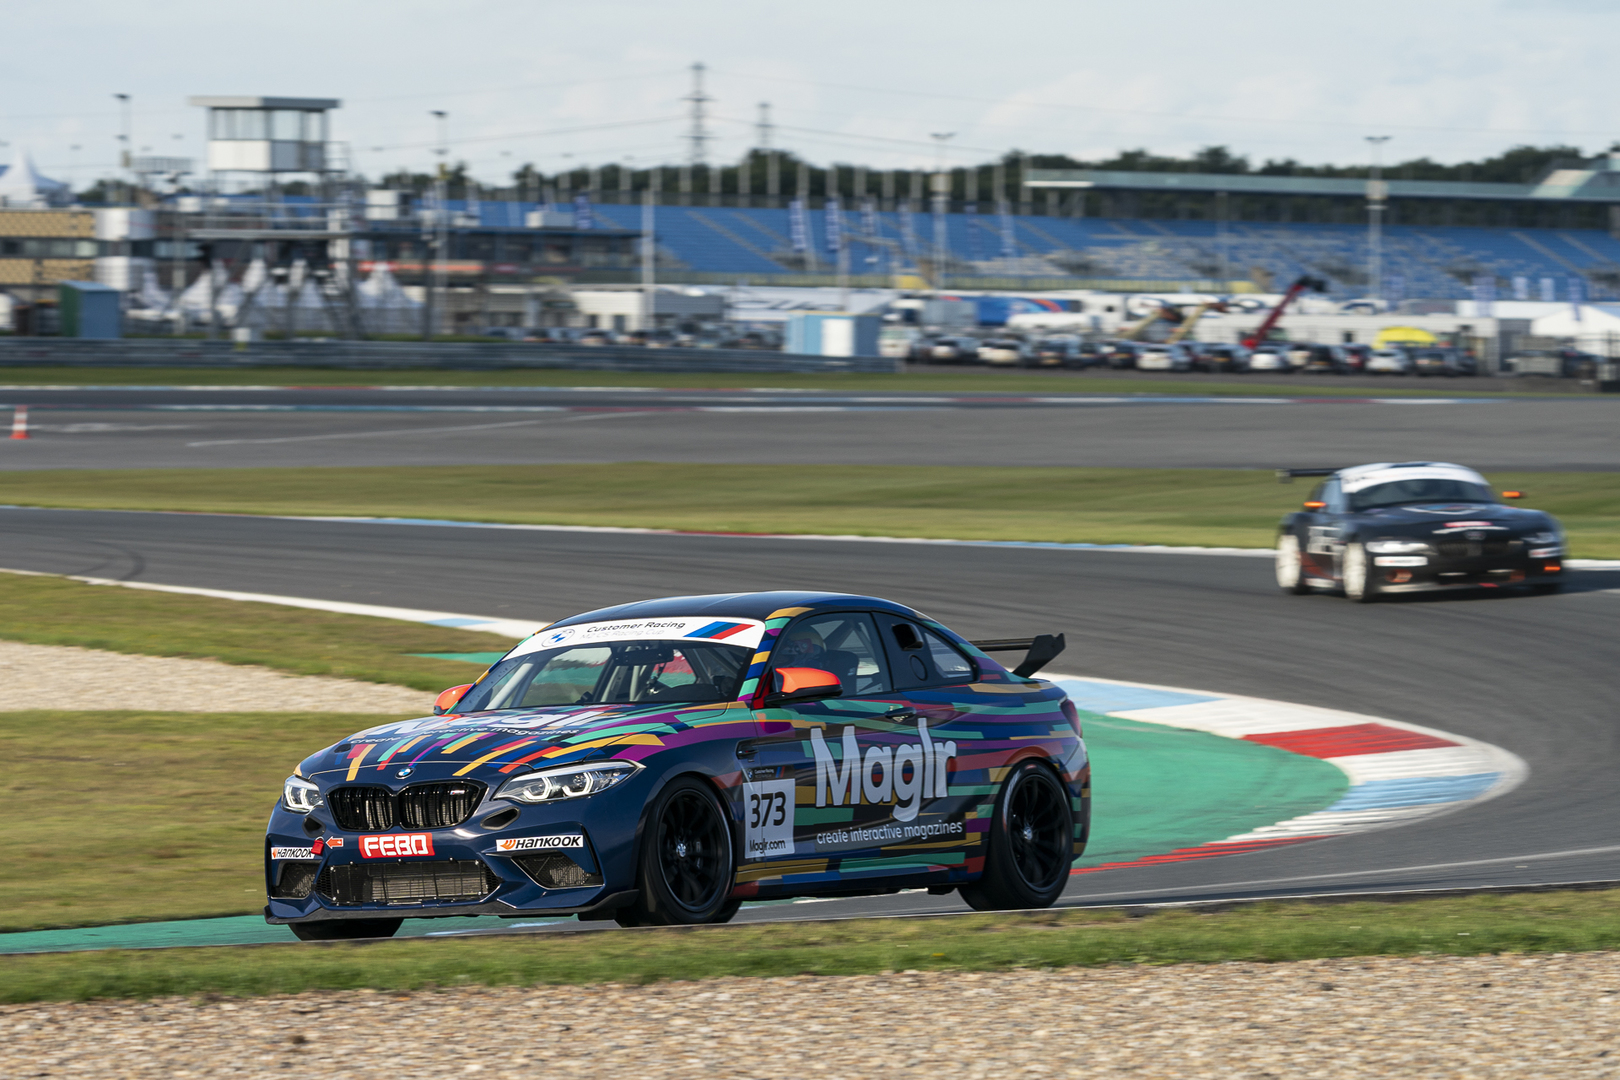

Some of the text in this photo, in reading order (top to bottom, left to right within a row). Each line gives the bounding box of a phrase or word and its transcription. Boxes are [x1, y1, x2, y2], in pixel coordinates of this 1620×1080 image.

[586, 621, 686, 633] Customer Racing
[645, 628, 665, 636] Cup
[490, 726, 580, 736] magazines
[811, 718, 957, 822] Maglr
[750, 791, 786, 829] 373
[816, 820, 963, 844] create interactive magazines
[364, 835, 429, 857] FEBO
[749, 838, 786, 854] Maglr.com
